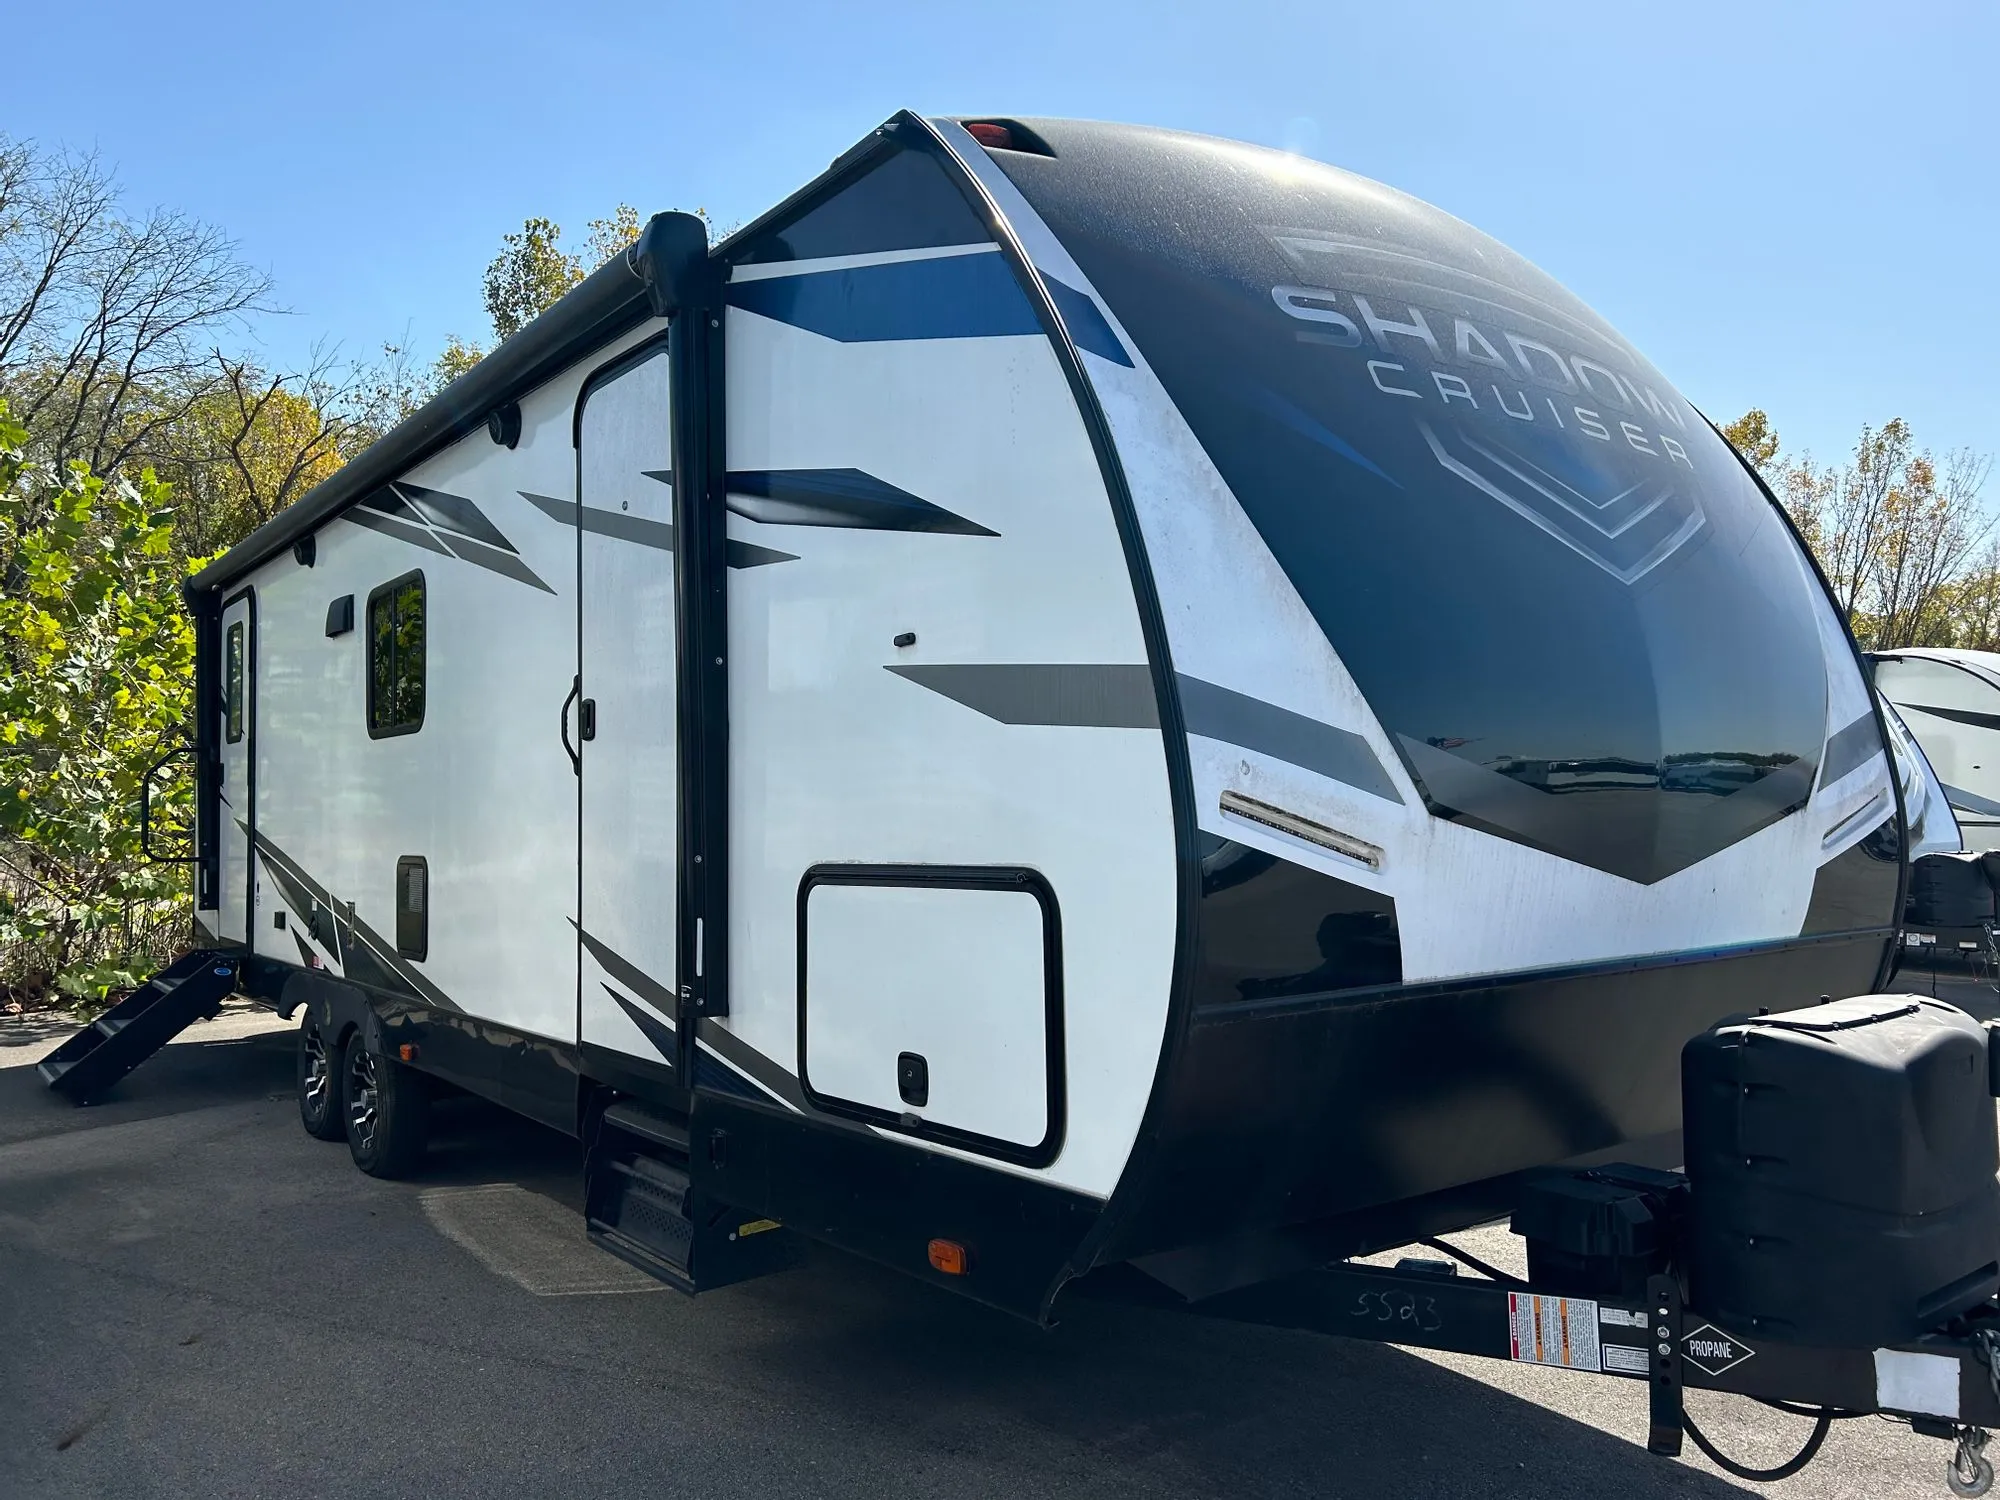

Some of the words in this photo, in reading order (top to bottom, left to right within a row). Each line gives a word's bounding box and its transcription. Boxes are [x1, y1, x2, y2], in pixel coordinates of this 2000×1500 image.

[1271, 285, 1687, 430] SHADOW
[1366, 359, 1693, 470] CRUISER
[1689, 1340, 1732, 1358] PROPANE
